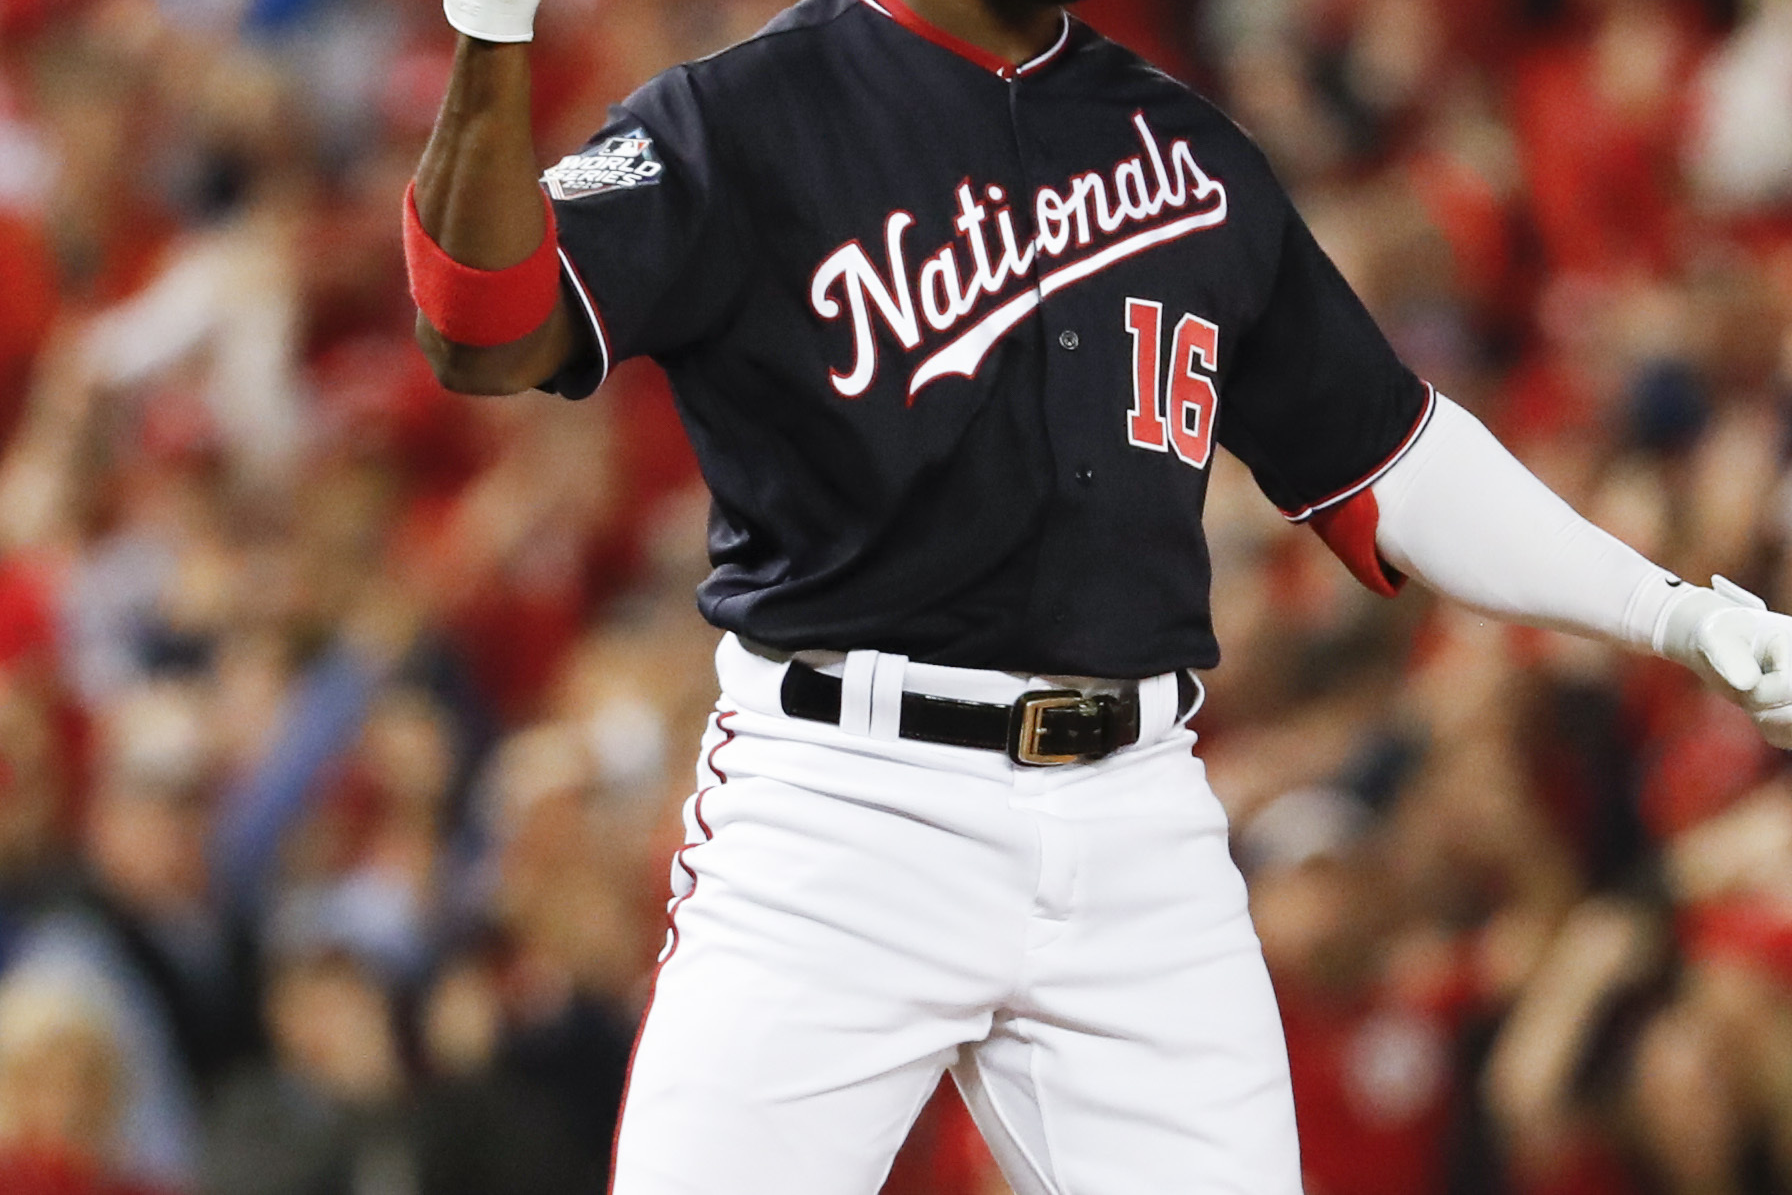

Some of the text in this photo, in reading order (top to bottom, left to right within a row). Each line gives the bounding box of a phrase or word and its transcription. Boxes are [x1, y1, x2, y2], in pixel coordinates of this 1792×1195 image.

[551, 169, 643, 187] SERIES
[557, 155, 662, 177] WORLD
[810, 110, 1228, 400] Nationals
[1125, 297, 1220, 470] 16
